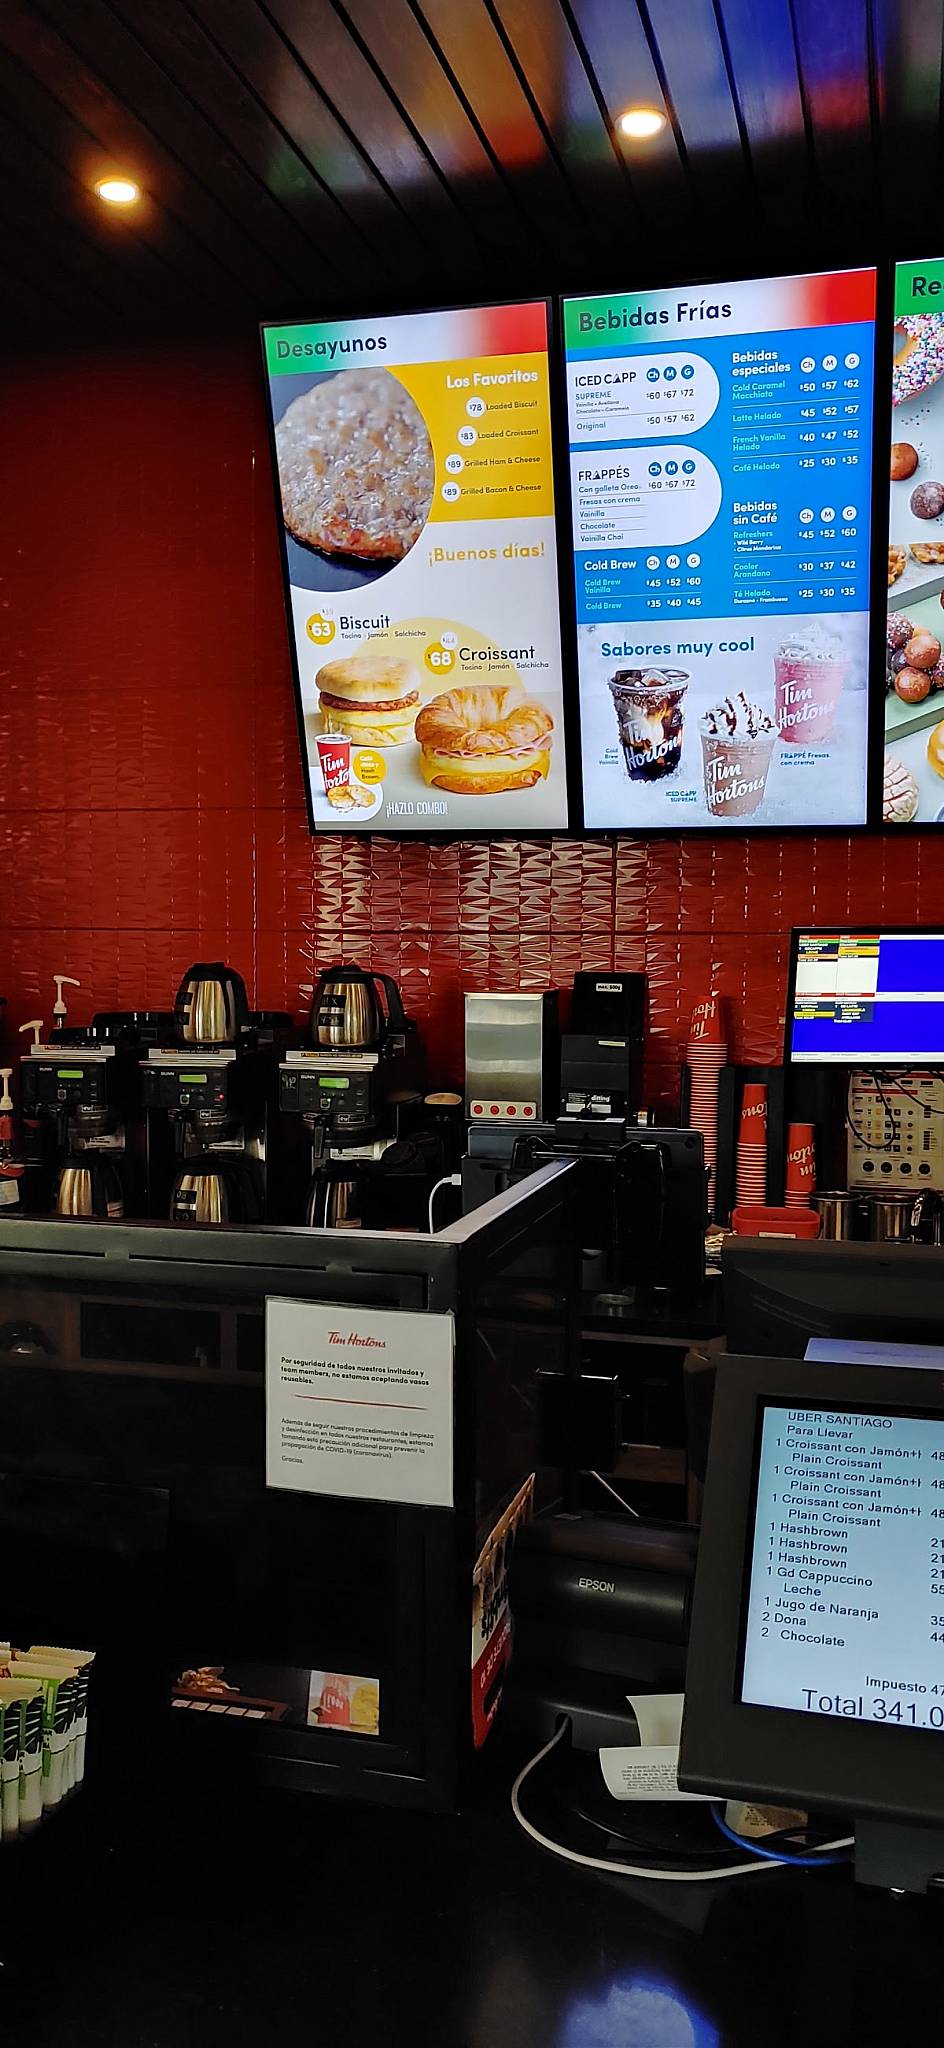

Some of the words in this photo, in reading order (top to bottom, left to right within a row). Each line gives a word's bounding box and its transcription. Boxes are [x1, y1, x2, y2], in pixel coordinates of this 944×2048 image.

[579, 306, 669, 332] Bebidas
[677, 300, 732, 322] Frías
[277, 335, 387, 360] Desayunos
[732, 350, 778, 363] Bebidas
[732, 361, 791, 378] especiales
[447, 375, 470, 389] Los
[473, 369, 538, 386] Favoritos
[575, 375, 602, 387] ICED
[604, 371, 637, 384] CAPP
[732, 384, 750, 392] Cold
[752, 380, 785, 390] Caramel
[800, 382, 815, 392] $50
[822, 381, 837, 390] $57
[844, 379, 859, 388] $62
[576, 391, 612, 400] SUPREME
[732, 390, 773, 400] Macchiato
[470, 403, 482, 412] $78
[486, 401, 513, 411] Loaded
[515, 400, 538, 409] Biscuit
[732, 414, 752, 422] Latte
[754, 412, 781, 420] Helado
[576, 421, 606, 431] Original
[461, 432, 474, 440] $83
[478, 430, 504, 439] Loaded
[506, 429, 539, 437] Croissant
[732, 435, 758, 443] French
[448, 460, 461, 468] $89
[464, 459, 488, 467] Grilled
[490, 458, 506, 466] Ham
[733, 464, 752, 472] Café
[753, 463, 780, 471] Helado
[800, 459, 815, 467] $25
[822, 458, 836, 466] $30
[843, 456, 858, 464] $35
[578, 465, 630, 481] FRAPPÉS
[444, 488, 457, 496] $89
[461, 487, 484, 495] Grilled
[594, 485, 619, 495] galleta
[617, 496, 641, 504] crema
[733, 501, 778, 513] Bebidas
[580, 522, 616, 530] Chocolate
[733, 515, 749, 525] sin
[751, 512, 778, 523] Café
[733, 530, 773, 539] Refreshers
[820, 530, 835, 538] $52
[842, 528, 856, 536] $60
[429, 547, 497, 567] ¡Buenos
[503, 541, 545, 559] días!
[584, 560, 608, 571] Cold
[611, 559, 637, 569] Brew
[667, 578, 681, 586] $52
[744, 589, 771, 597] Helado
[340, 614, 390, 630] Biscuit
[367, 632, 389, 640] Jamón
[459, 645, 535, 661] Croissant
[601, 642, 672, 657] Sabores
[677, 643, 713, 658] muy
[719, 637, 755, 652] cool
[488, 663, 510, 671] Jamón
[780, 680, 813, 705] Tim
[320, 753, 345, 773] Tim
[708, 756, 742, 783] Tim
[707, 776, 766, 809] Hortons
[386, 802, 414, 818] ¡HAZLO
[416, 800, 448, 815] COMBO!
[328, 1331, 346, 1345] Tim
[347, 1332, 386, 1348] Hortons
[281, 1366, 298, 1374] team
[299, 1369, 330, 1378] members,
[371, 1376, 408, 1384] aceptando
[387, 1367, 419, 1376] invitados
[281, 1376, 314, 1384] reusables.
[789, 1412, 822, 1423] UBER
[826, 1415, 892, 1429] SANTIAGO
[787, 1425, 814, 1436] Para
[818, 1427, 853, 1439] Llevar
[786, 1438, 841, 1452] Croissant
[845, 1445, 866, 1454] con
[793, 1453, 821, 1464] Plain
[826, 1456, 882, 1469] Croissant
[784, 1466, 840, 1480] Croissant
[843, 1473, 864, 1482] con
[791, 1481, 819, 1492] Plain
[824, 1484, 881, 1498] Croissant
[782, 1494, 839, 1508] Croissant
[842, 1501, 863, 1511] con
[788, 1509, 818, 1521] Plain
[823, 1513, 881, 1527] Croissant
[781, 1523, 848, 1539] Hashbrown
[779, 1538, 847, 1553] Hashbrown
[778, 1552, 847, 1568] Hashbrown
[578, 1577, 615, 1593] EPSON
[777, 1567, 795, 1578] Gd
[799, 1569, 873, 1587] Cappuccino
[783, 1583, 822, 1596] Leche
[775, 1598, 806, 1612] Jugo
[809, 1601, 826, 1612] de
[829, 1604, 879, 1621] Naranja
[763, 1612, 770, 1621] 2
[774, 1613, 807, 1626] Dona
[761, 1627, 769, 1637] 2
[780, 1630, 845, 1647] Chocolate
[865, 1675, 927, 1694] Impuesto
[801, 1689, 863, 1717] Total
